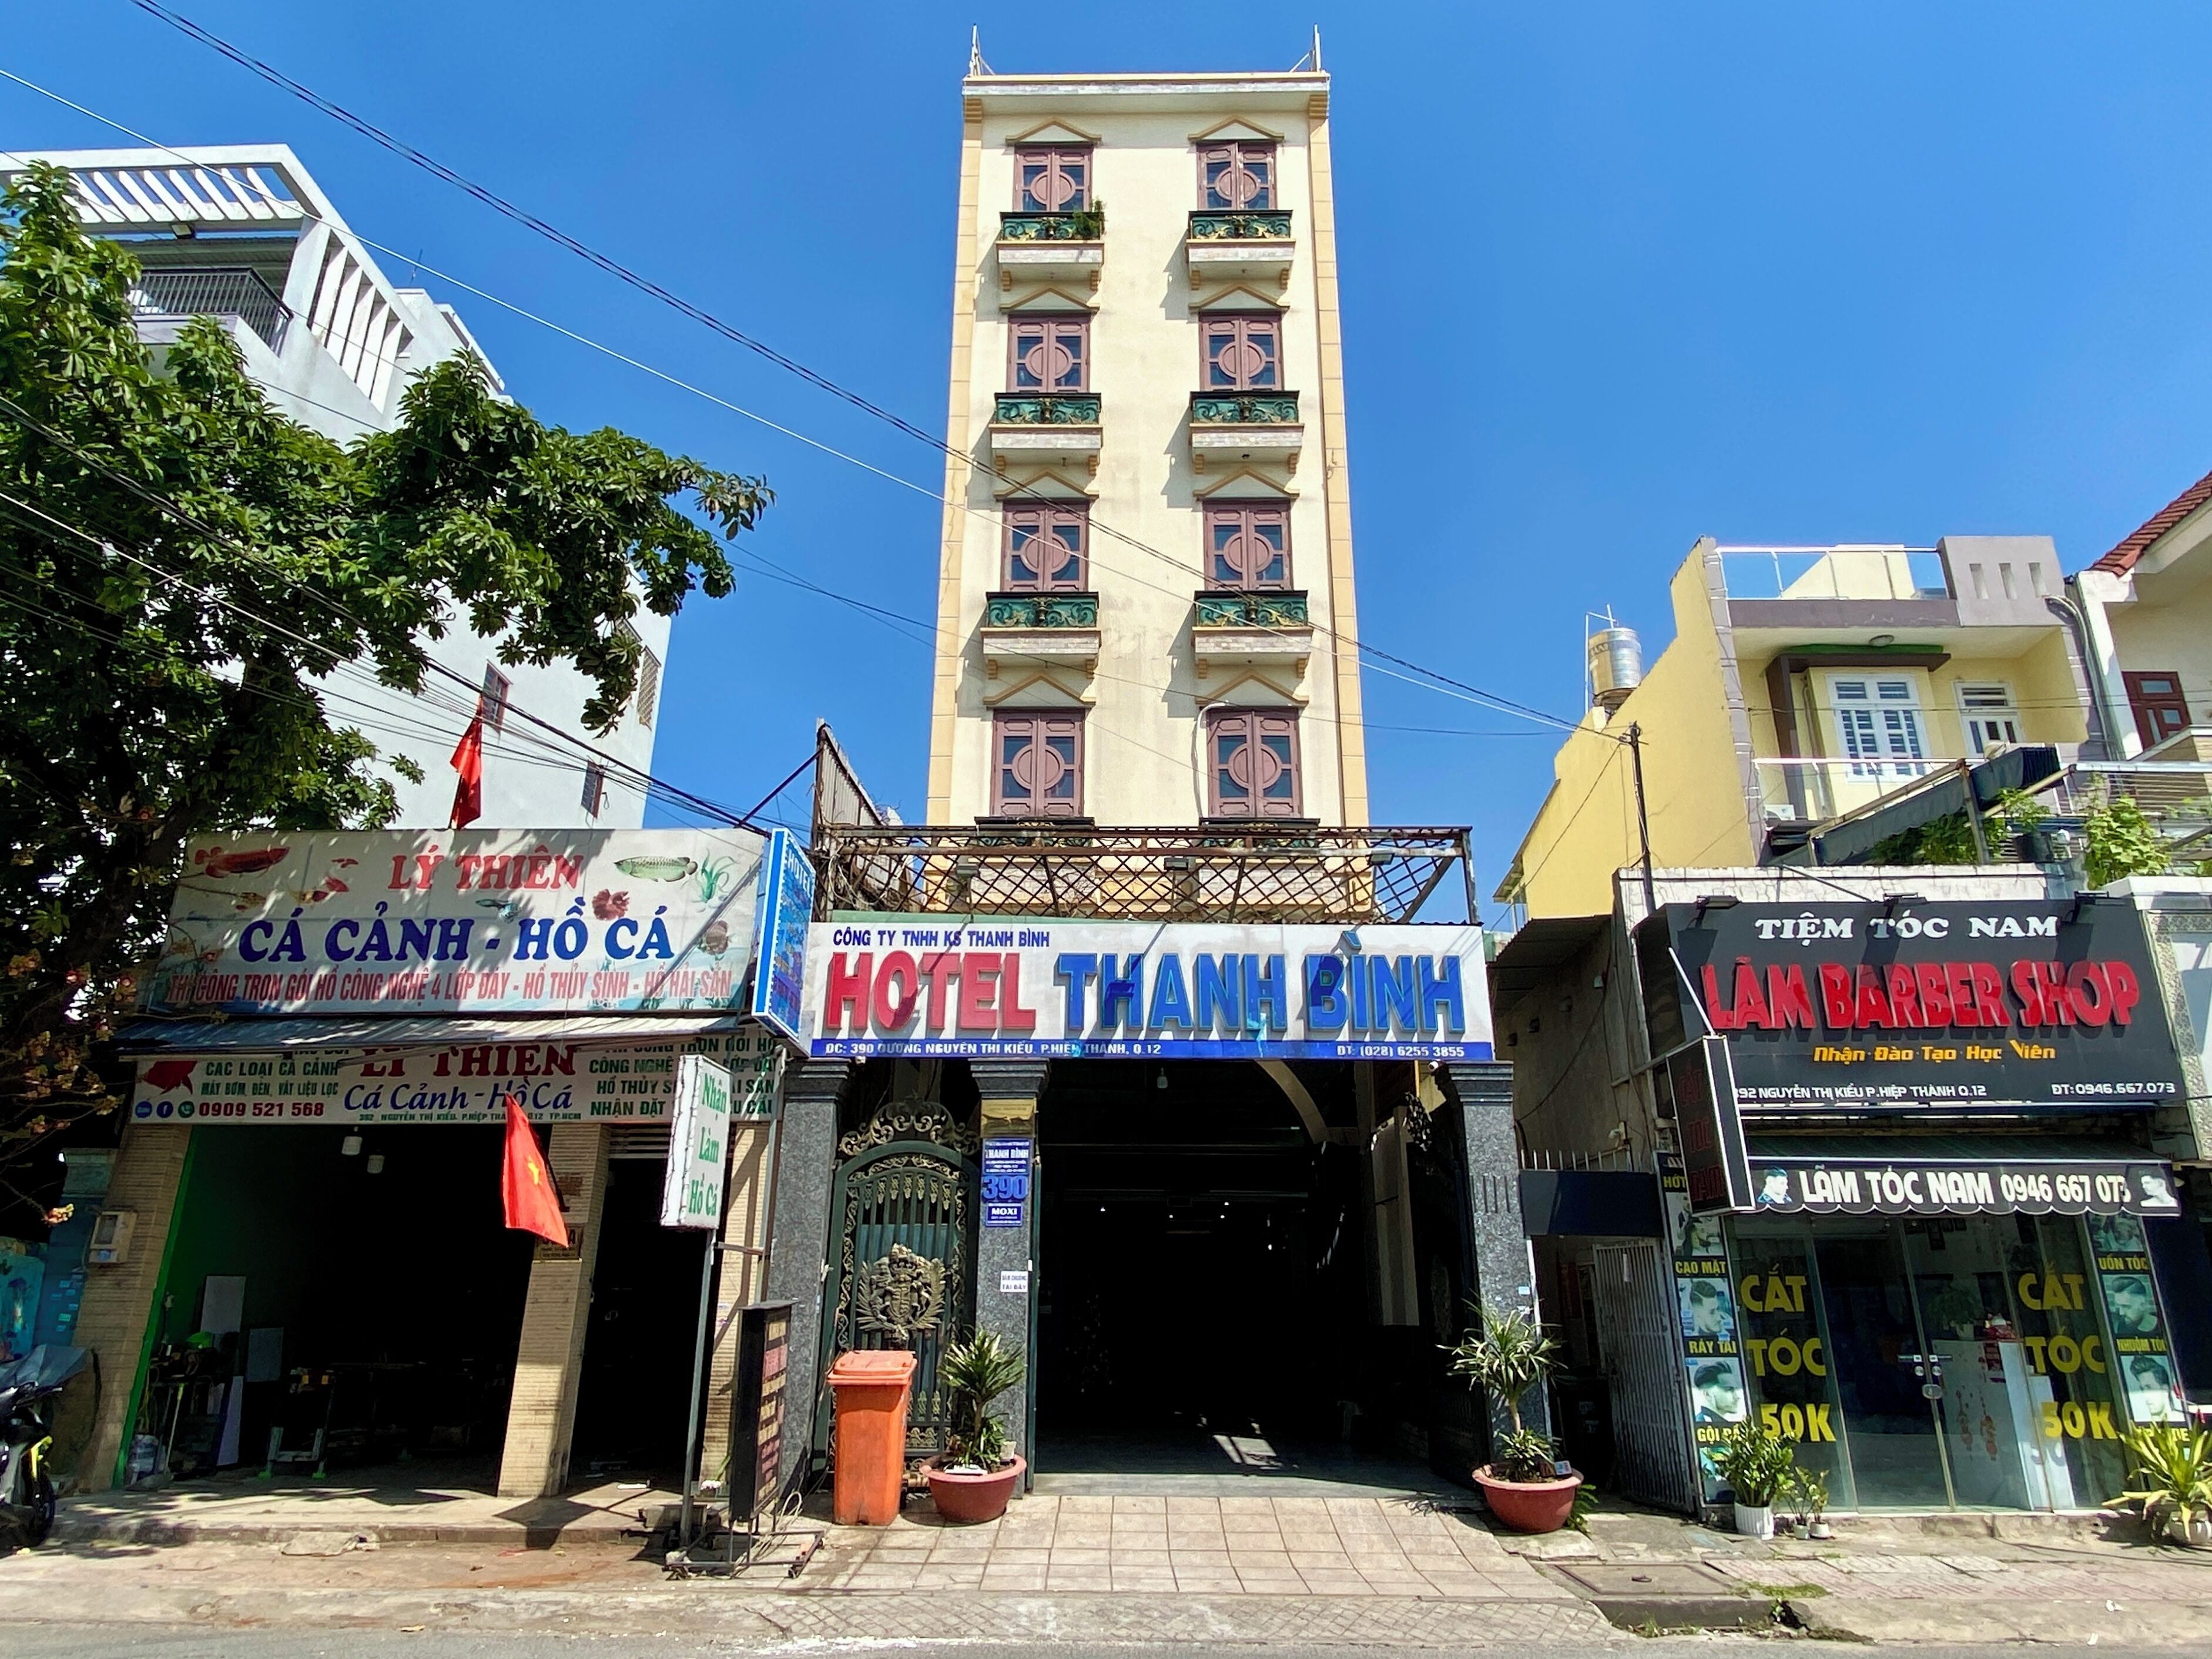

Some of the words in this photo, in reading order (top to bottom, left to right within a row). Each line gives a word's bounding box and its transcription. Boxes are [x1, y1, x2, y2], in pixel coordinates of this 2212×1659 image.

[388, 844, 444, 890] LÝ
[455, 844, 583, 890] THIÊN
[787, 849, 812, 898] HOTEL
[238, 907, 306, 963] CÁ
[324, 901, 474, 963] CẢNH
[513, 896, 589, 961] HỒ
[605, 905, 675, 960] CÁ
[833, 927, 871, 946] CÔNG
[878, 930, 896, 946] TY
[902, 930, 938, 946] TNHH
[944, 931, 961, 947] KS
[967, 931, 1014, 947] THANH
[1018, 928, 1050, 947] BÌNH
[1755, 910, 1854, 947] TIỆM
[1870, 909, 1949, 939] TÓC
[1968, 916, 2058, 939] NAM
[195, 968, 239, 1001] CÔNG
[242, 973, 283, 1007] TRỌN
[284, 968, 313, 1001] GÓI
[339, 967, 383, 1001] CÔNG
[386, 967, 430, 1007] NGHỆ
[431, 973, 441, 1000] 4
[444, 967, 475, 1000] LỚP
[477, 964, 510, 1000] ĐÁY
[523, 963, 547, 1000] HỒ
[550, 962, 587, 1000] THỦY
[591, 971, 629, 999] SINH
[669, 961, 696, 998] HẢI
[699, 962, 732, 998] SẢN
[826, 950, 1037, 1030] HOTEL
[1054, 951, 1287, 1033] THANH
[1302, 930, 1466, 1033] BÌNH
[1701, 955, 1816, 1029] LÂM
[1817, 961, 2013, 1029] BARBER
[2009, 959, 2140, 1027] SHOP
[589, 1056, 629, 1073] CÔNG
[634, 1056, 673, 1076] NGHỆ
[850, 1043, 874, 1053] 390
[926, 1041, 977, 1054] NGUYỄN
[1360, 1045, 1393, 1057] (028)
[1397, 1046, 1429, 1057] 6255
[1433, 1047, 1464, 1057] 3855
[1814, 1046, 1865, 1065] Nhận
[1874, 1045, 1913, 1061] Đào
[1921, 1046, 1956, 1063] Tạo
[1966, 1046, 2002, 1063] Học
[2009, 1039, 2056, 1060] Viên
[239, 1062, 273, 1080] LOẠI
[303, 1057, 339, 1077] CẢNH
[596, 1075, 616, 1094] HỒ
[621, 1074, 658, 1094] THỦY
[199, 1102, 246, 1117] 0909
[252, 1102, 284, 1117] 521
[291, 1101, 324, 1117] 568
[344, 1083, 384, 1111] Cá
[390, 1082, 469, 1111] Cảnh
[487, 1075, 531, 1111] Hồ
[532, 1081, 574, 1110] Cá
[591, 1098, 634, 1118] NHẬN
[640, 1097, 666, 1118] ĐẶT
[702, 1073, 727, 1120] Nhận
[1759, 1082, 1811, 1098] NGUYỄN
[1811, 1087, 1834, 1101] THỊ
[1909, 1084, 1956, 1097] THÀNH
[1958, 1085, 1988, 1097] Q.12
[698, 1126, 720, 1164] Làm
[705, 1182, 718, 1216] Cá
[982, 1175, 1028, 1200] 390
[1798, 1164, 1861, 1204] LÂM
[1865, 1164, 1925, 1205] TÓC
[1925, 1171, 1995, 1205] NAM
[2000, 1173, 2054, 1204] 0946
[2057, 1174, 2091, 1204] 667
[2095, 1174, 2131, 1204] 073
[1675, 1261, 1698, 1276] CẠO
[1701, 1259, 1726, 1276] MẶT
[2098, 1254, 2124, 1270] UỐN
[1740, 1263, 1807, 1313] CẮT
[2017, 1259, 2084, 1311] CẮT
[1689, 1338, 1714, 1354] RÁY
[1719, 1340, 1737, 1355] TAI
[1746, 1328, 1827, 1377] TÓC
[2025, 1326, 2107, 1373] TÓC
[1697, 1425, 1720, 1445] GỘI
[1759, 1403, 1836, 1442] 50K
[2040, 1401, 2118, 1440] 50K
